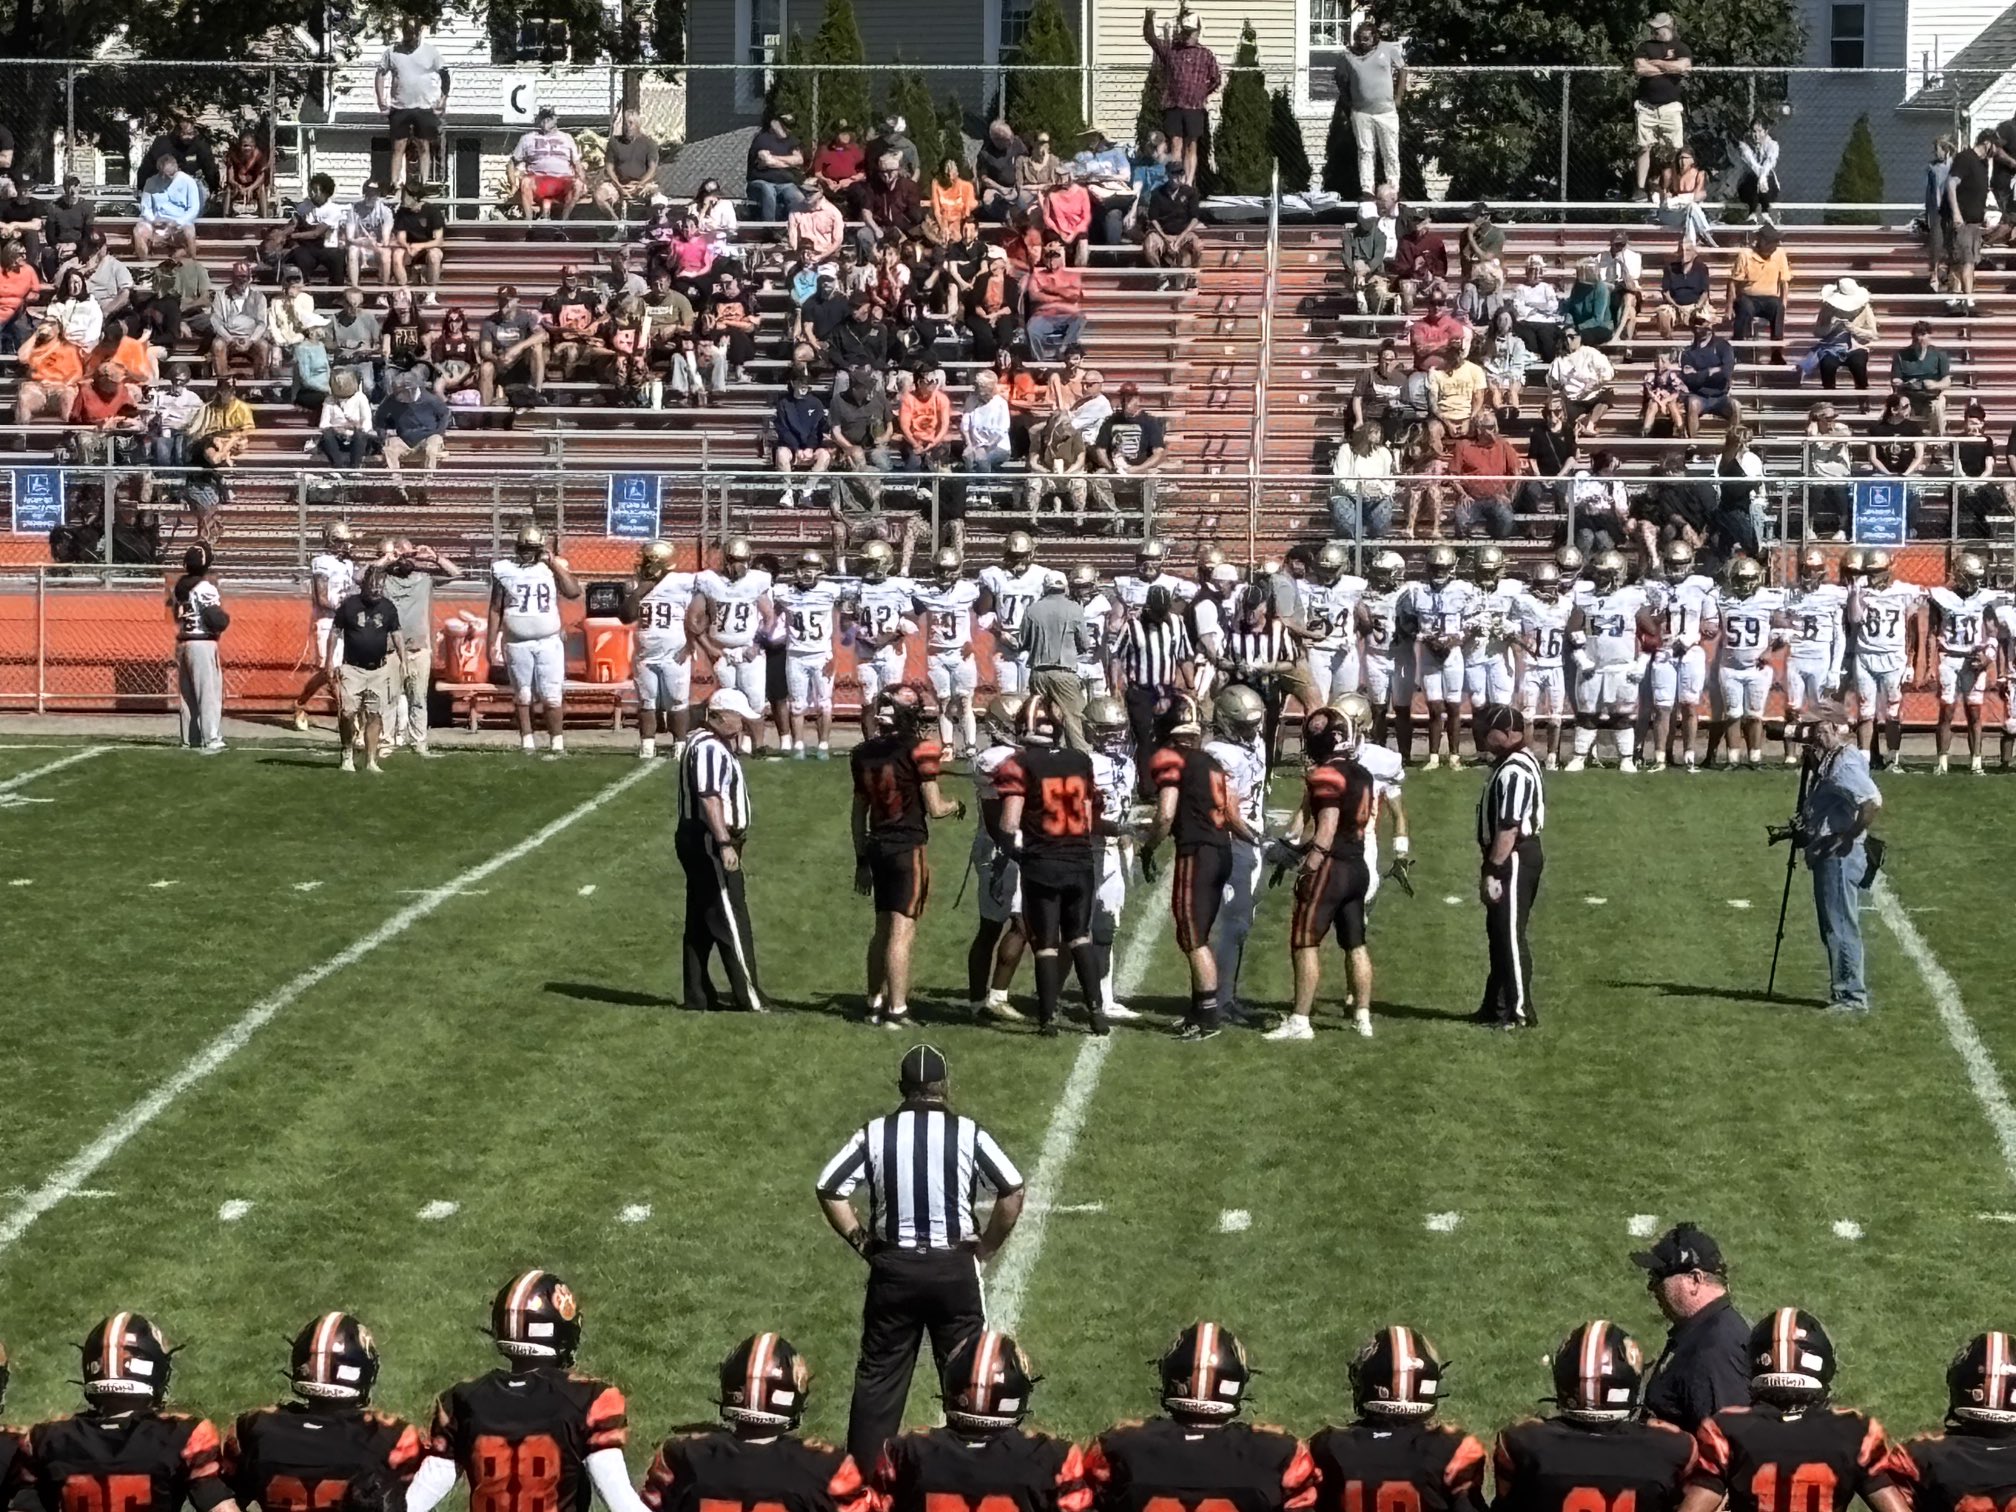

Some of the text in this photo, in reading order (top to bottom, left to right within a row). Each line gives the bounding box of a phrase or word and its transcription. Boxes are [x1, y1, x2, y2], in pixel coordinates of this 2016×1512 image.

[511, 84, 527, 114] C
[517, 583, 550, 613] 78
[1534, 627, 1563, 658] 16
[1726, 616, 1760, 647] 59
[472, 1434, 561, 1512] 88
